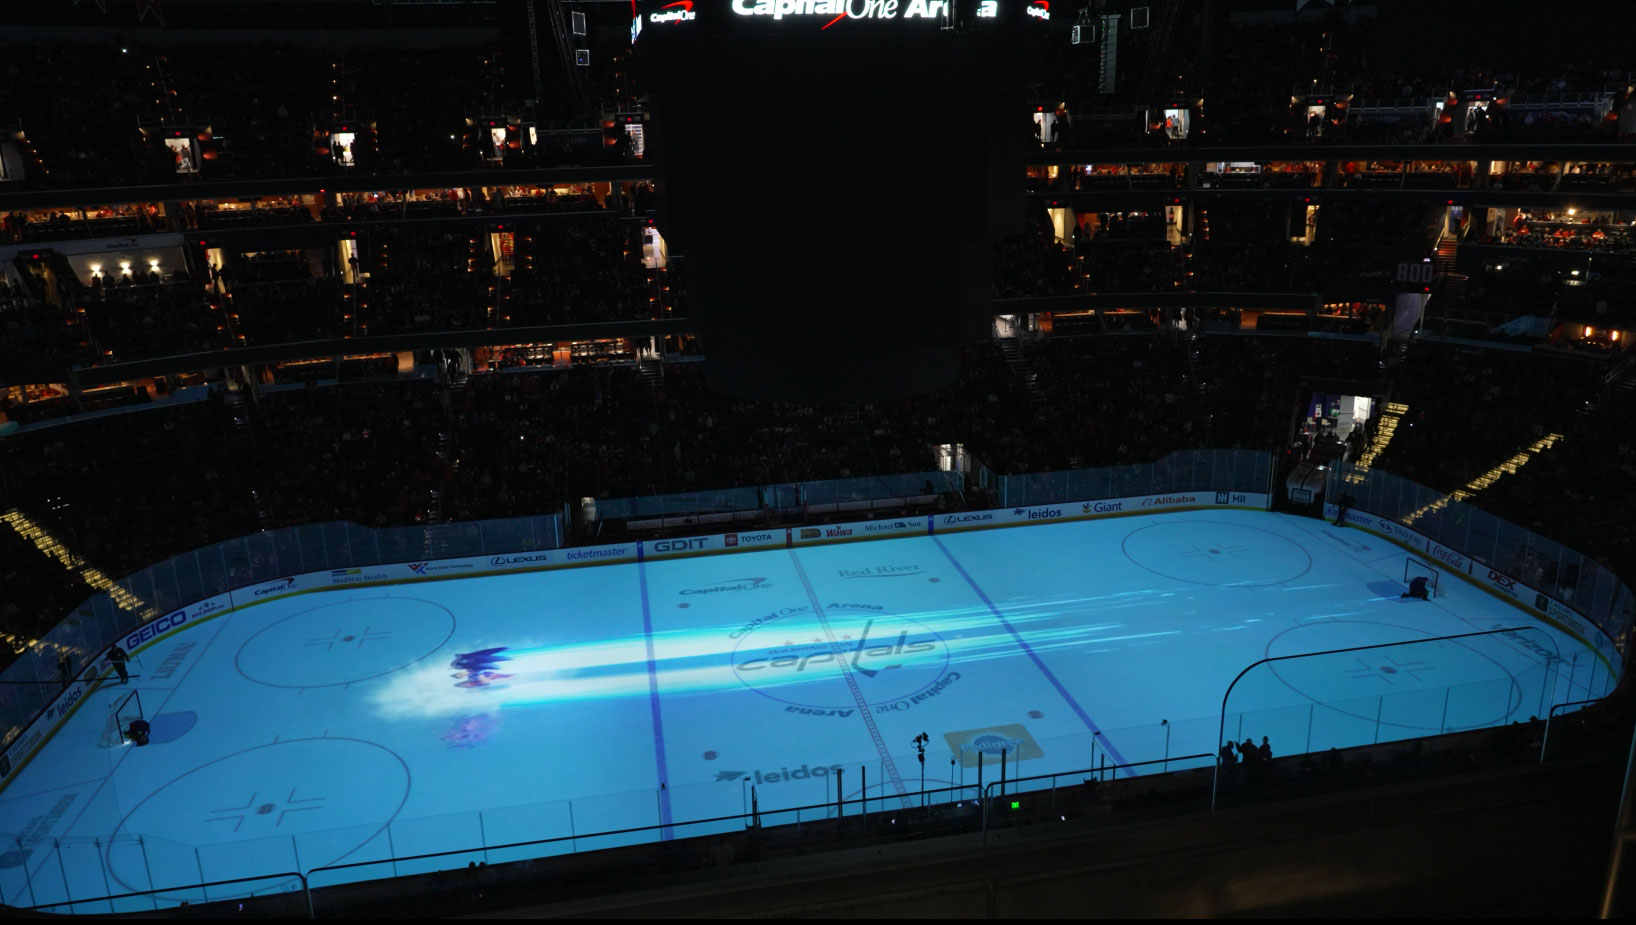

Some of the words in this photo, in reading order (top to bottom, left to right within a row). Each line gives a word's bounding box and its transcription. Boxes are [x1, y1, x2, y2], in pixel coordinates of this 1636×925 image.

[1154, 496, 1196, 505] Alibaba
[1028, 508, 1061, 520] leidos
[1094, 502, 1122, 513] Giant
[957, 513, 992, 522] LEXUS
[826, 528, 852, 538] Wawa
[865, 522, 894, 531] Michael
[654, 538, 708, 552] GDIT
[741, 534, 772, 543] TOYOTA
[507, 555, 546, 564] LEXUS
[567, 547, 625, 560] ticketmaster
[838, 567, 872, 577] Red
[875, 564, 920, 574] River
[332, 576, 362, 585] MedStar
[364, 574, 388, 583] Health
[1488, 570, 1516, 591] DEX
[728, 613, 777, 639] Capital
[779, 605, 809, 617] One
[827, 602, 884, 612] Arena
[127, 611, 187, 650] GEICO
[911, 672, 960, 705] Capital
[57, 687, 82, 717] leidos
[877, 701, 910, 714] One
[785, 705, 854, 718] Arena
[755, 764, 845, 785] leidos
